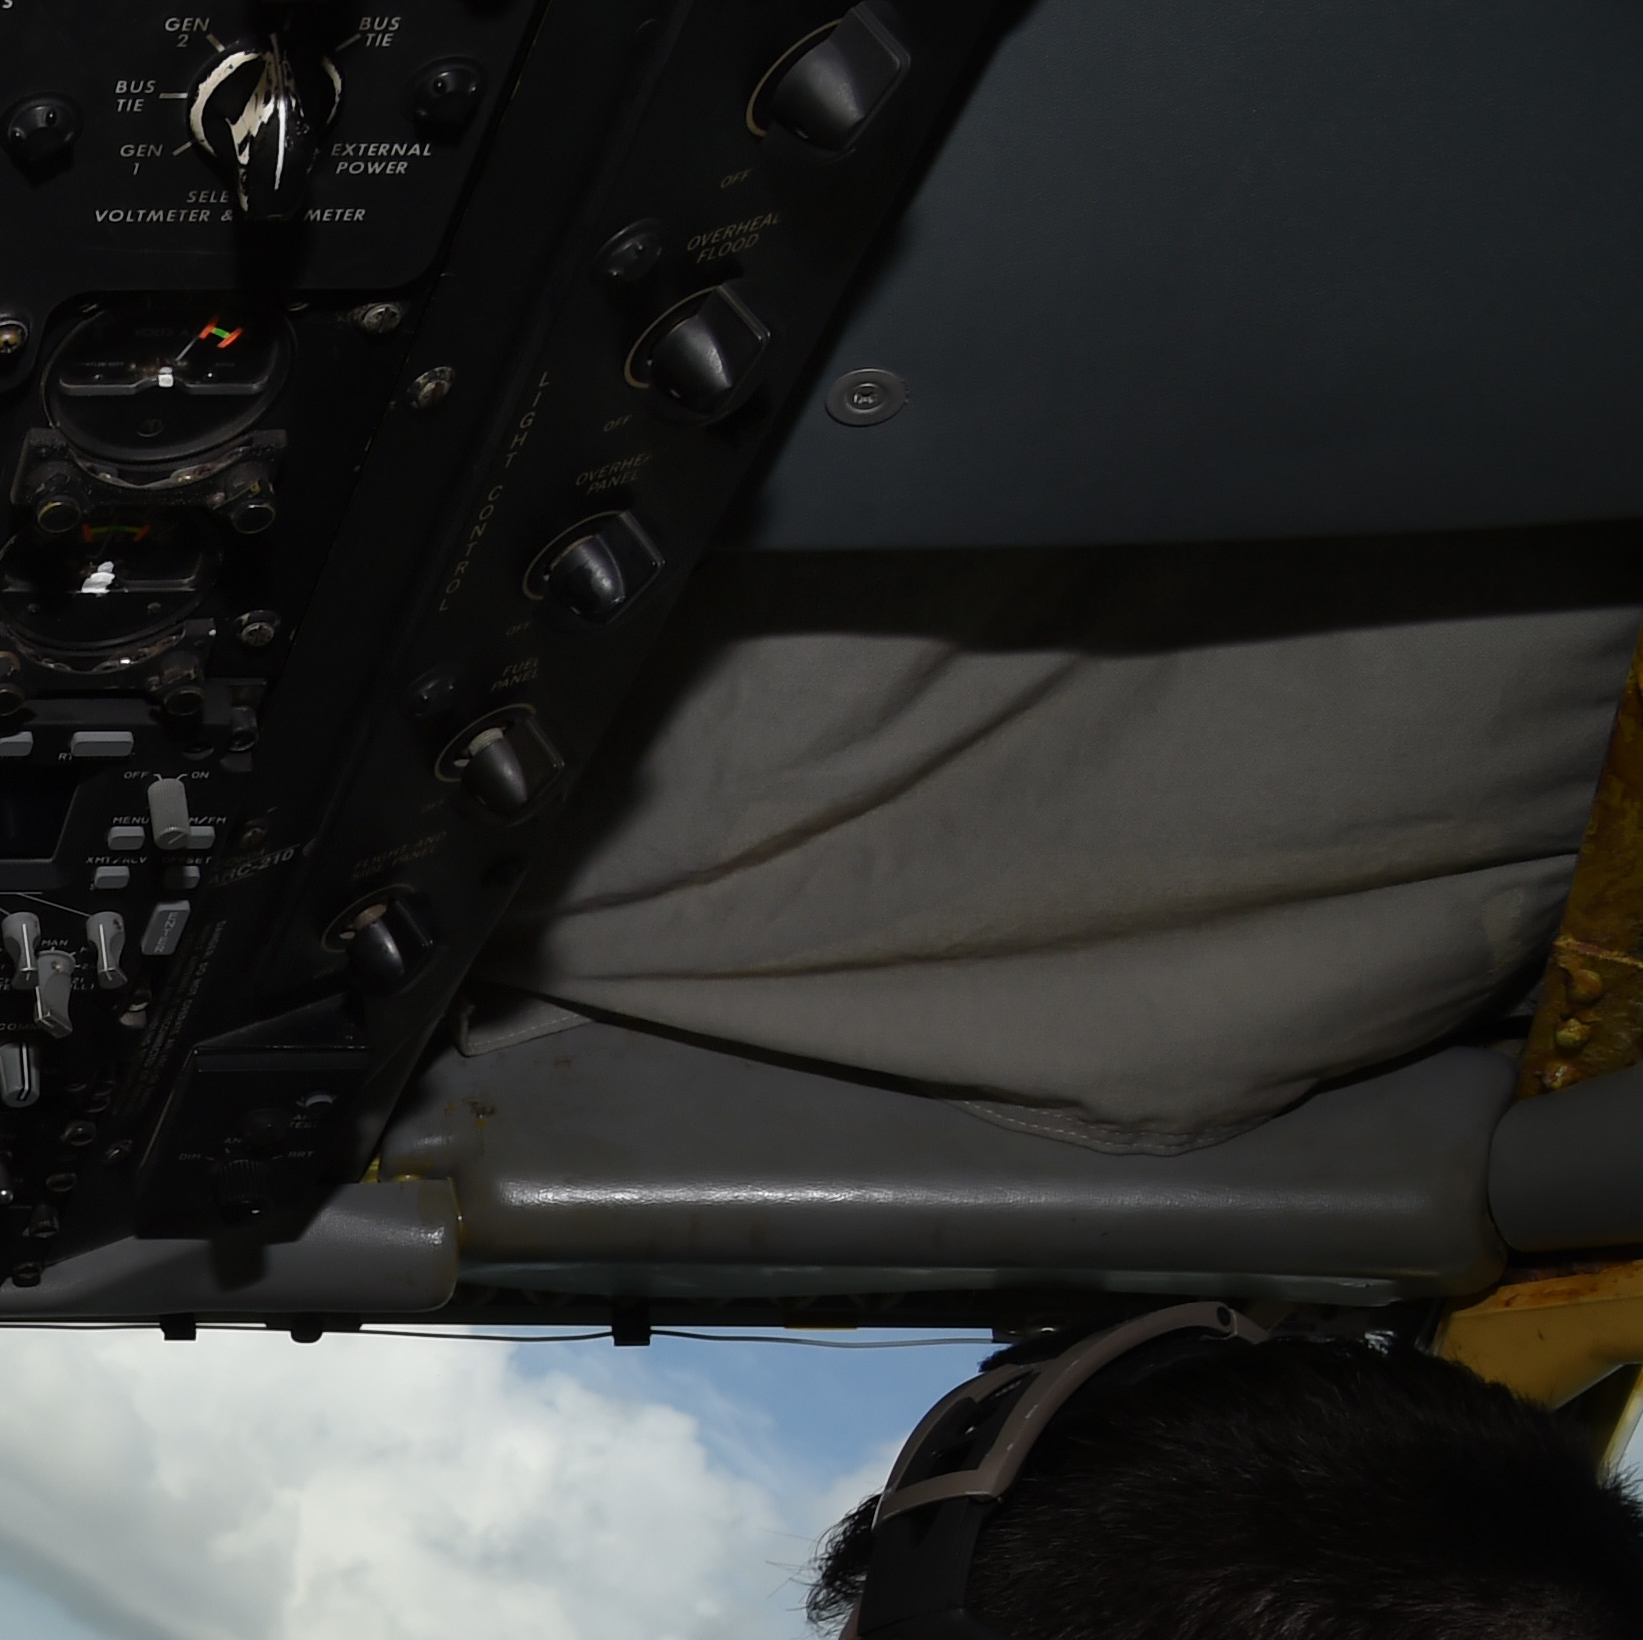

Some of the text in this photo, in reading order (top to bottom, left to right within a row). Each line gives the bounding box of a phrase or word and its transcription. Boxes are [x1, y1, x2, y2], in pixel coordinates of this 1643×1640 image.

[165, 18, 209, 31] GEN
[359, 17, 401, 30] BUS
[177, 34, 188, 47] 2
[366, 33, 394, 47] TIE
[115, 80, 155, 93] BUS
[117, 99, 144, 112] TIE
[120, 144, 162, 157] GEN
[332, 143, 431, 156] EXTERNAL
[336, 162, 408, 174] POWER
[96, 209, 365, 222] VOLTMETER & METER
[697, 234, 759, 263] FLOOD
[439, 372, 549, 611] LIGHT CONTROL
